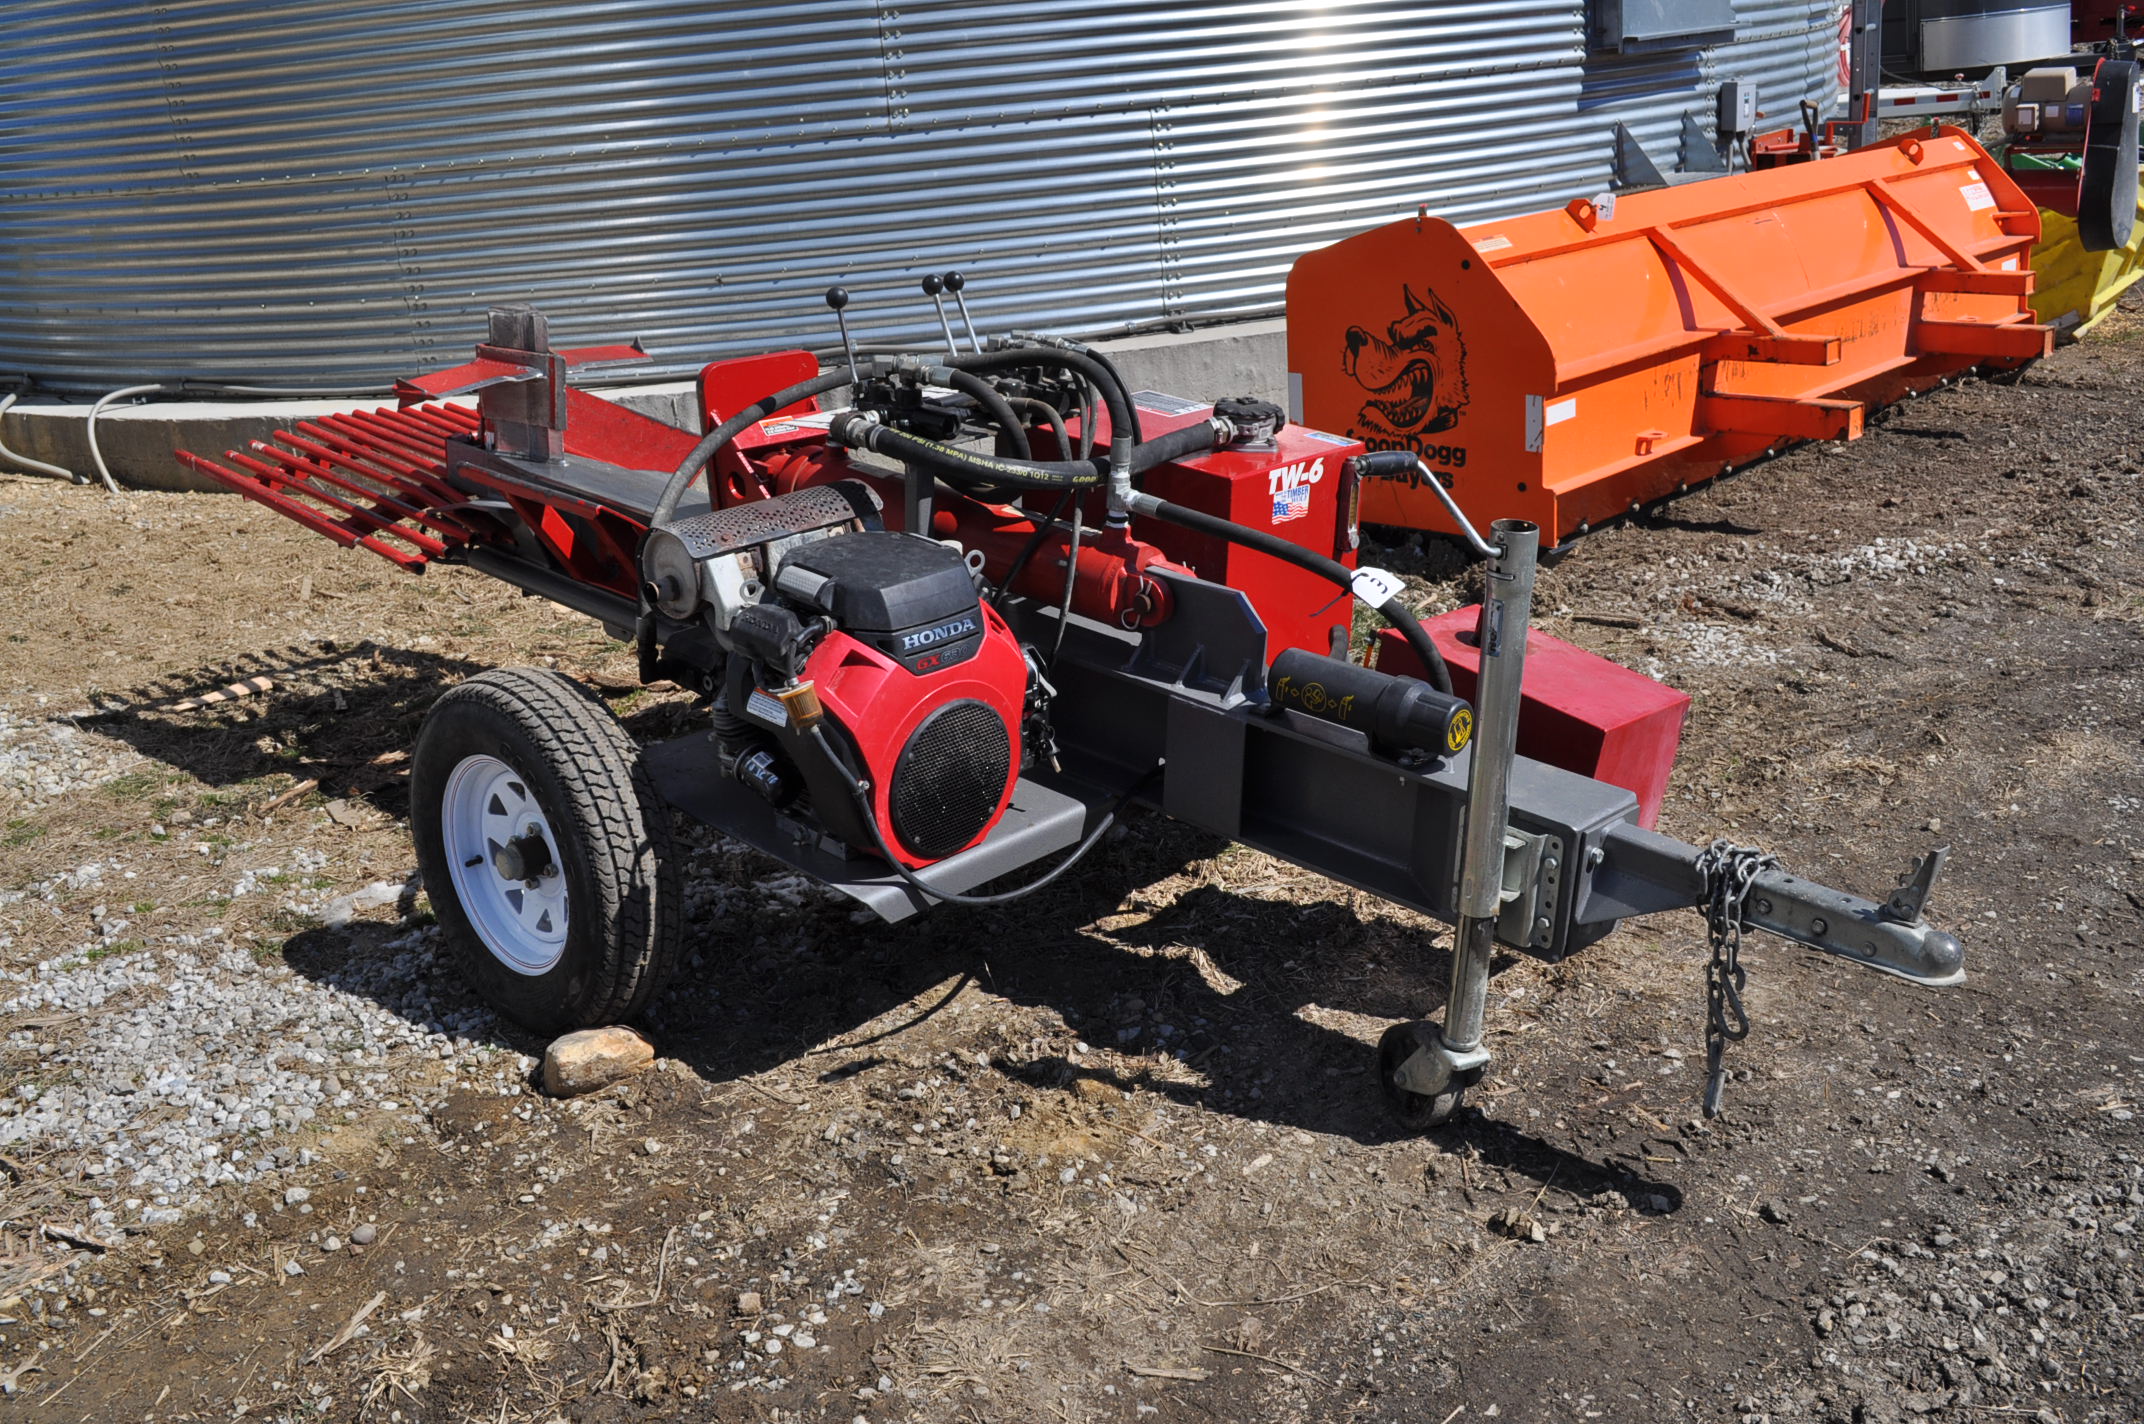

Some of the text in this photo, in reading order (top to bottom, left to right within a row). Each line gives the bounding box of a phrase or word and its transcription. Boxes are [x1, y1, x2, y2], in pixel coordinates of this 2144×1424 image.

[946, 447, 968, 462] MPA)
[968, 455, 994, 469] MSHA
[1269, 457, 1324, 495] TW-6
[1287, 485, 1309, 499] TIMBER
[902, 618, 976, 650] HONDA
